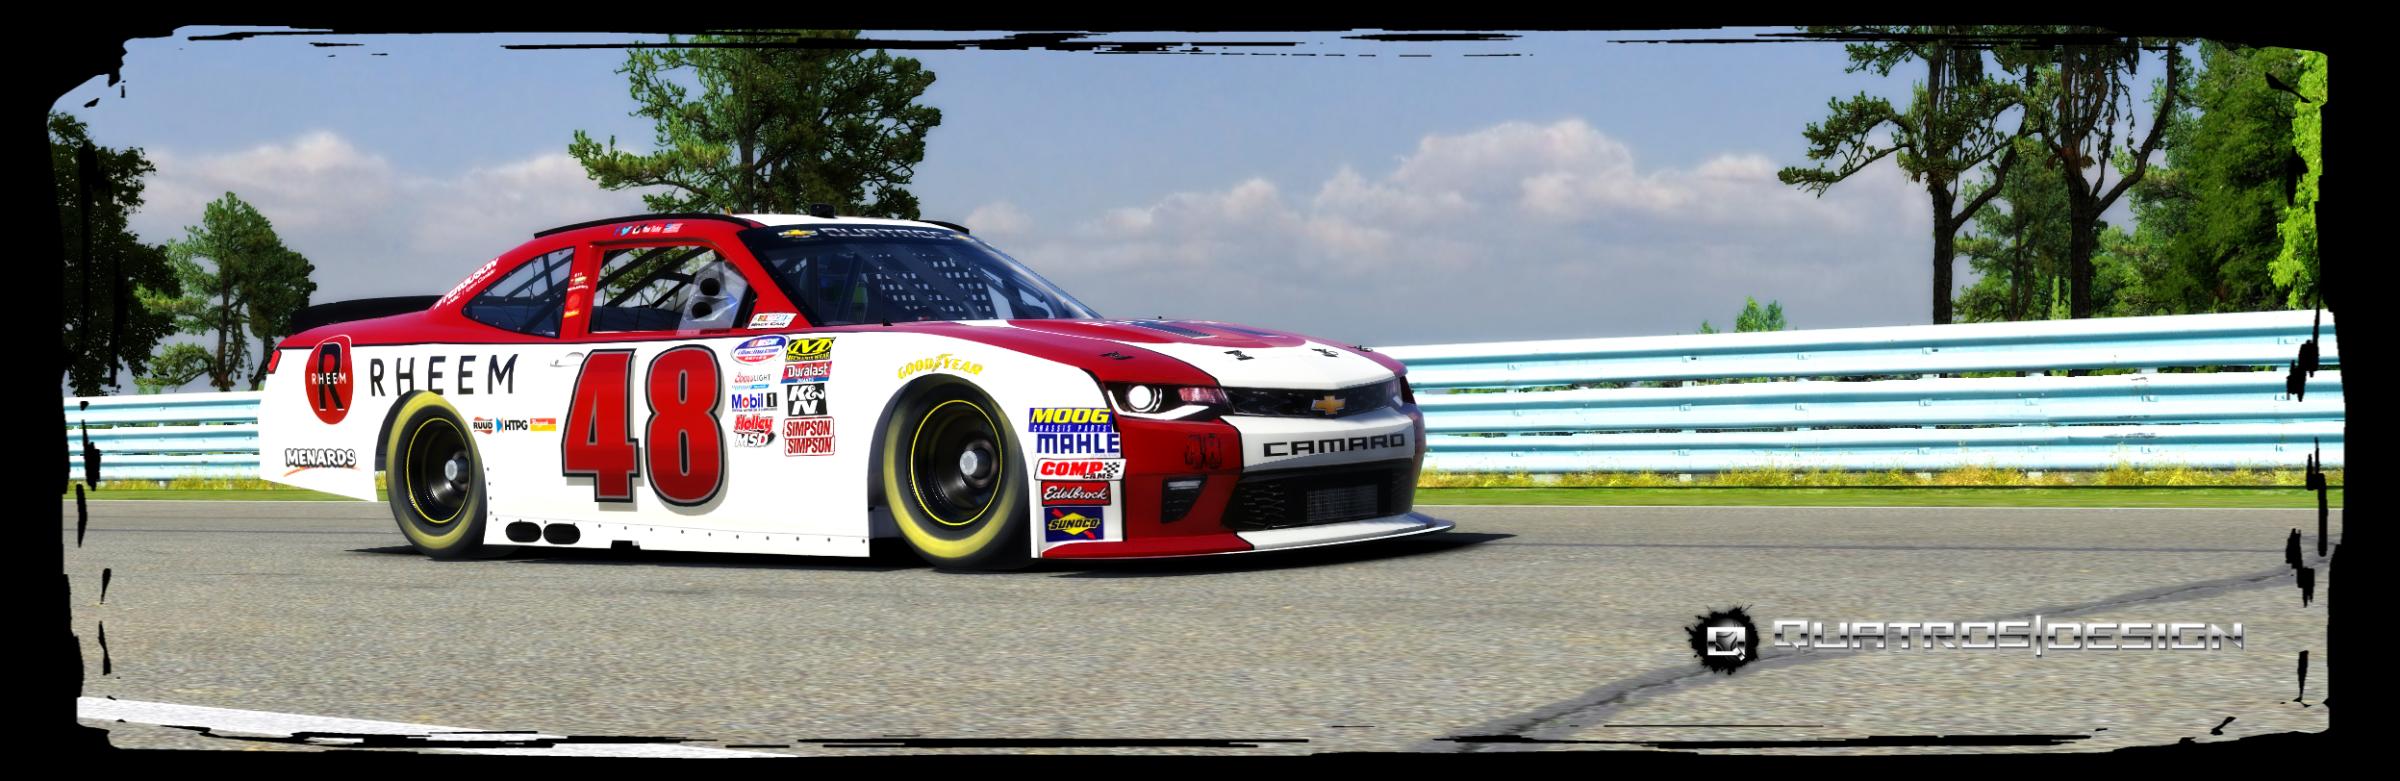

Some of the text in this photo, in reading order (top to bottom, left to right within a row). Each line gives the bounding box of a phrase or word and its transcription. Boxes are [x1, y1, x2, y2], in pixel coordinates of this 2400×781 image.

[311, 372, 347, 384] RHEEM
[370, 353, 519, 396] RHEEM
[786, 362, 829, 378] Duralast
[732, 392, 777, 409] Mobil 1
[1031, 408, 1111, 424] MOOG
[504, 419, 528, 430] HTPG
[561, 344, 725, 507] 48
[734, 414, 774, 435] Holley
[786, 420, 831, 437] SIMPSON
[1033, 424, 1108, 432] CHASSIS PARTS
[735, 433, 771, 448] MSD
[787, 438, 832, 454] SIMPSON
[1036, 433, 1120, 454] MAHLE
[1263, 433, 1405, 457] CAMARO
[285, 448, 357, 467] MENARDS
[1040, 461, 1104, 476] COMP
[1044, 485, 1108, 500] Edelbrock
[1049, 519, 1100, 530] SUNOCO
